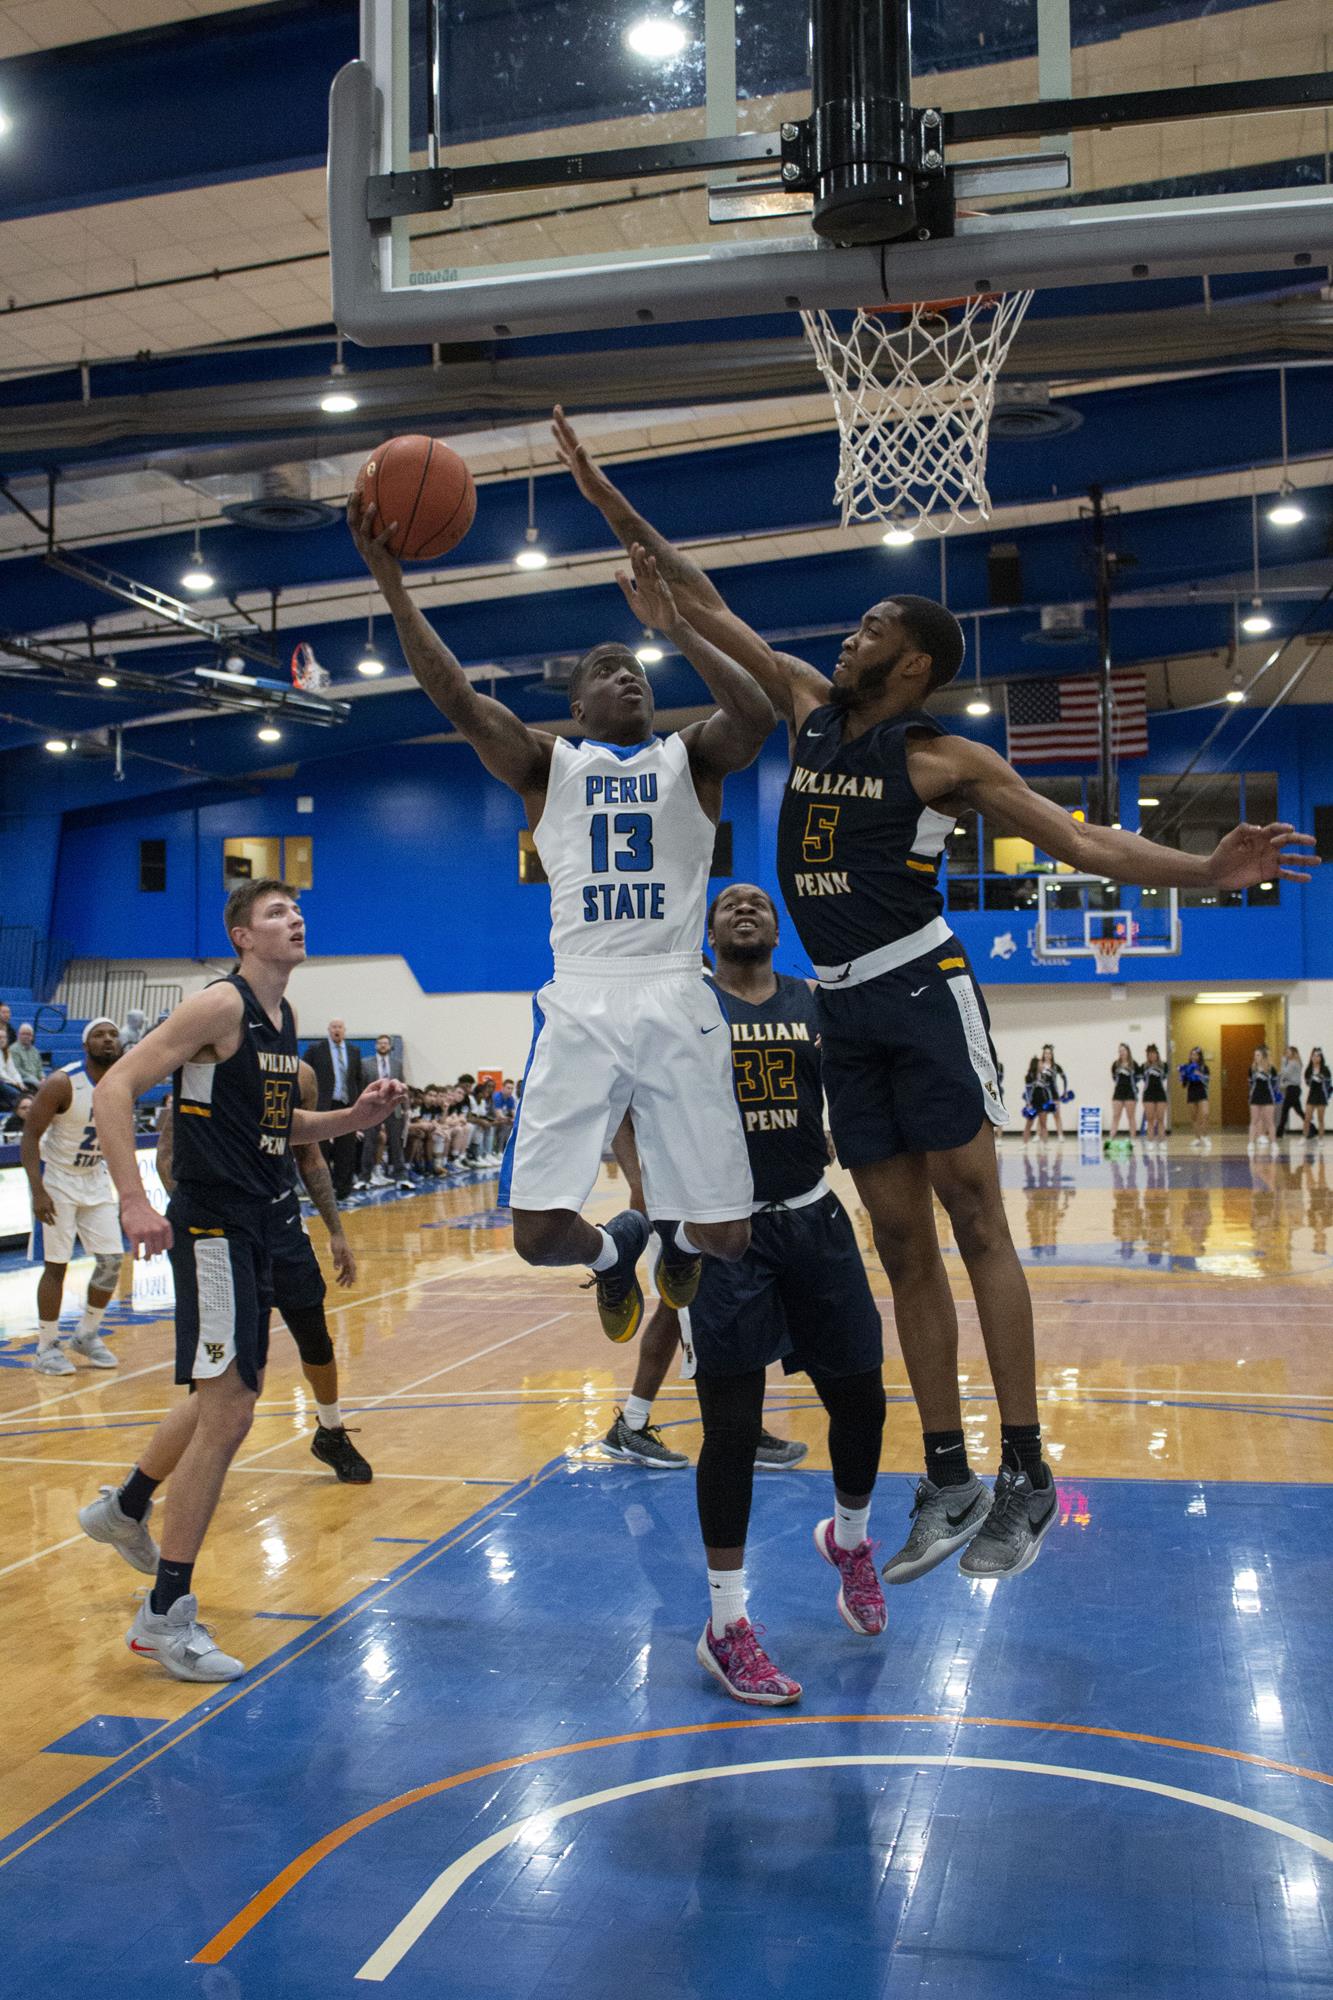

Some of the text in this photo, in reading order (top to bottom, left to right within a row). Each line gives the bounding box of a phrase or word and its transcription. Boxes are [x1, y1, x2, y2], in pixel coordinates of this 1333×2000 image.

[586, 773, 658, 806] PERU
[791, 765, 883, 800] WILLIAM
[589, 812, 654, 874] 13
[802, 803, 840, 863] 5
[794, 871, 852, 897] PENN
[582, 883, 665, 922] STATE
[731, 1023, 810, 1041] ILLIAM
[732, 1048, 798, 1102] 32
[259, 1079, 292, 1129] 23
[745, 1108, 798, 1132] PENN
[1080, 1107, 1101, 1135] BLUE
[80, 1126, 101, 1151] 2
[203, 1342, 225, 1364] WP
